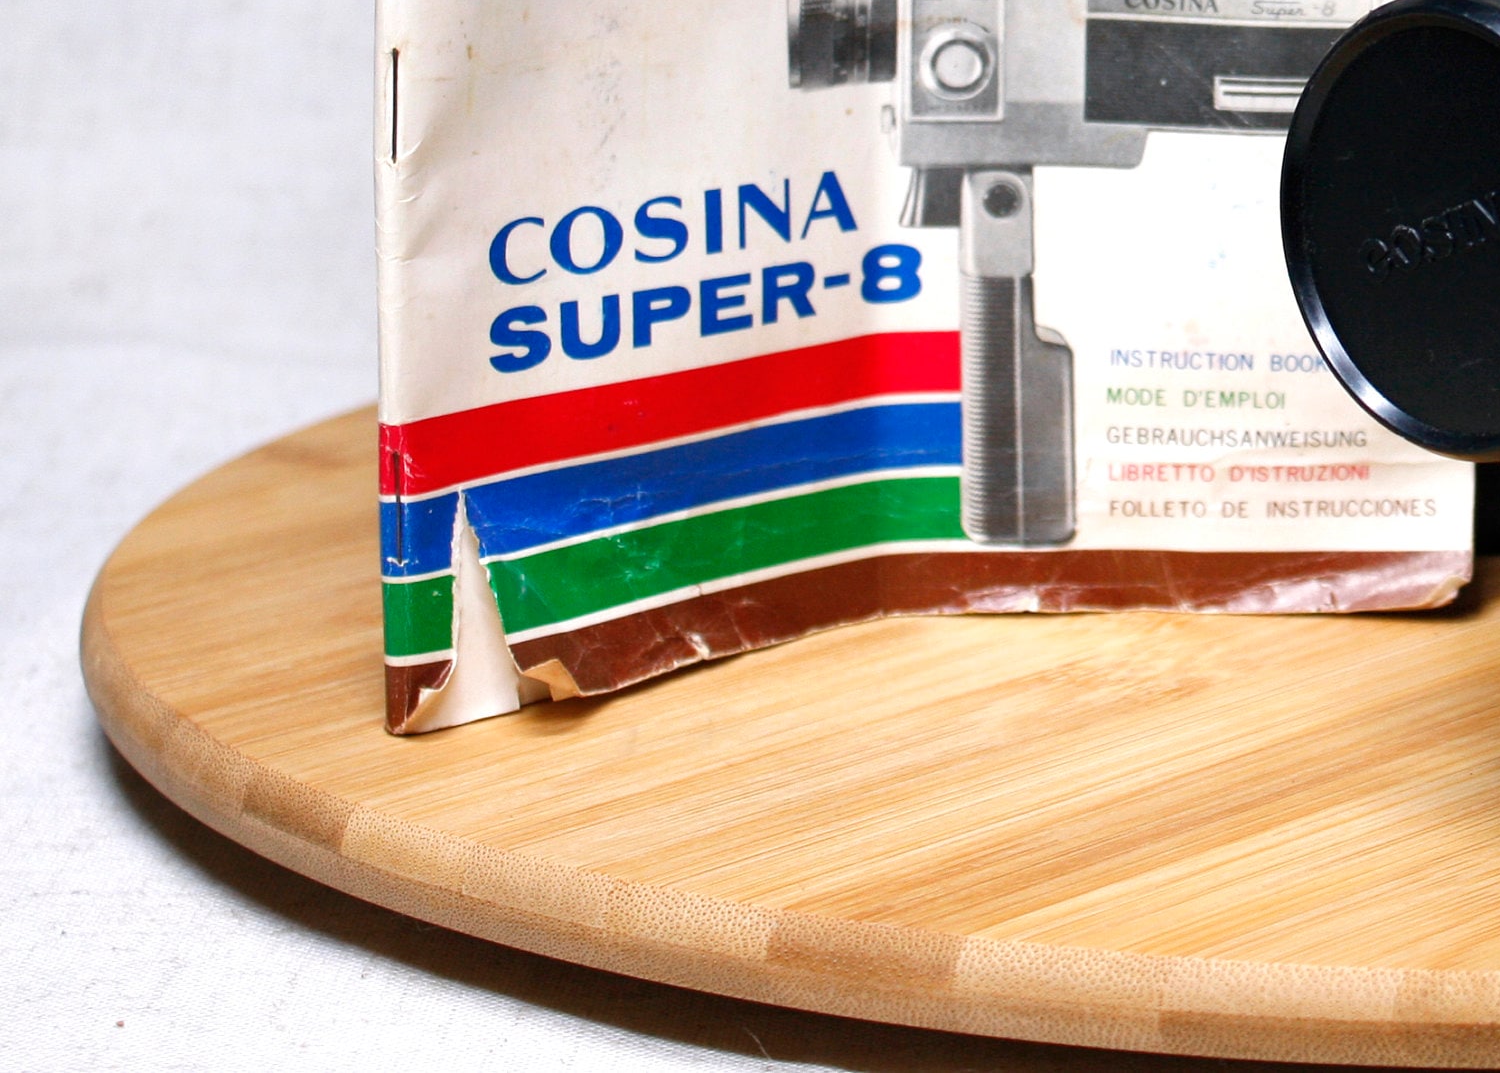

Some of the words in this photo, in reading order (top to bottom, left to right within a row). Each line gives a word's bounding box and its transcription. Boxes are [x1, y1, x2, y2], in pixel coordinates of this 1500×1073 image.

[488, 169, 859, 286] COSINA
[488, 242, 923, 374] SUPER-8
[1109, 349, 1255, 373] INSTRUCTION
[1106, 387, 1167, 408] MODE
[1182, 389, 1286, 410] D'EMPLOI
[1106, 426, 1368, 449] GEBRAUCHSANWEISUNG
[1107, 462, 1216, 483] LIBRETTO
[1229, 463, 1371, 483] D'ISTRUZIONI
[1108, 499, 1207, 519] FOLLETO
[1221, 500, 1250, 519] DE
[1266, 498, 1437, 519] INSTRUCCIONES
